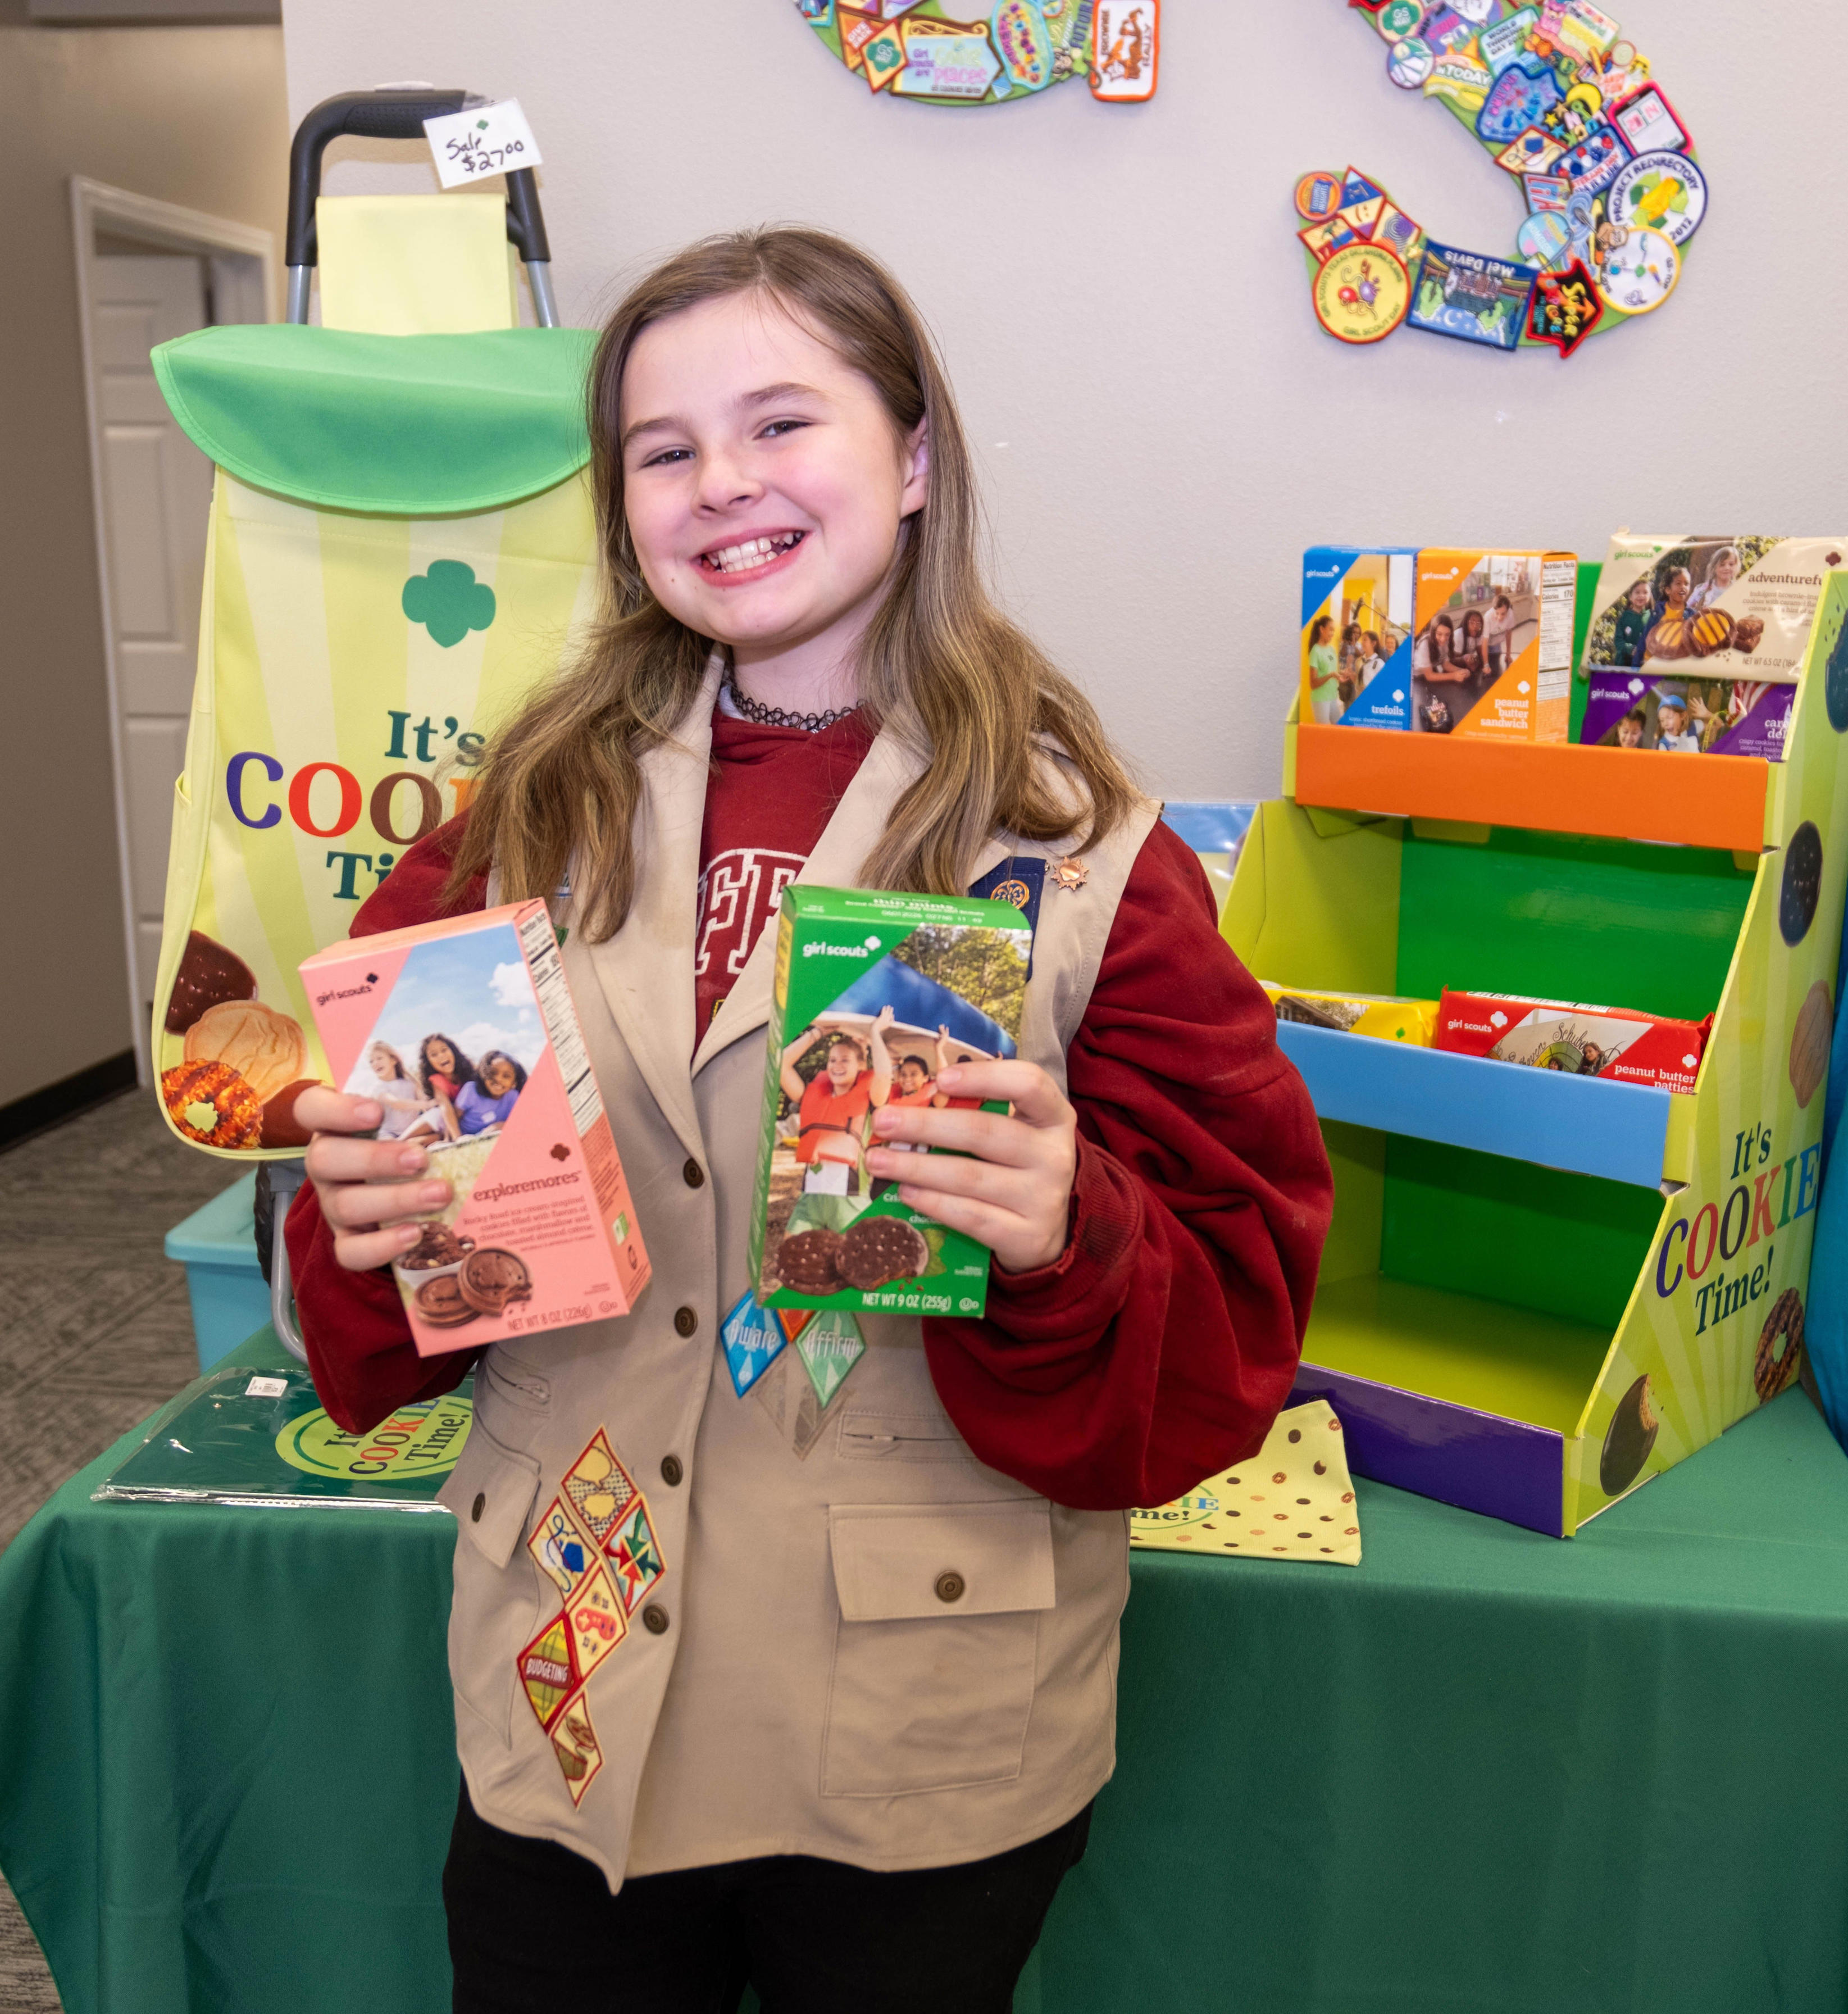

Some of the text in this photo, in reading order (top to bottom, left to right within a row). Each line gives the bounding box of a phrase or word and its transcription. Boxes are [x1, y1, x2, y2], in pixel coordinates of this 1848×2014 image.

[1069, 0, 1094, 49] FUTUR
[1445, 63, 1494, 85] TODAY
[1614, 171, 1636, 222] PROJECT
[1633, 157, 1699, 190] REDIRECTORY
[1669, 217, 1693, 240] 2012
[1444, 251, 1516, 279] Mel Davis
[1362, 319, 1390, 335] SCOUT
[1614, 550, 1627, 560] girl
[1742, 657, 1753, 665] NET
[1754, 657, 1763, 665] WT
[1773, 658, 1782, 667] OZ
[1782, 659, 1796, 668] (184
[1494, 698, 1529, 708] peanut
[1591, 689, 1630, 700] girl scouts
[1371, 704, 1404, 716] trefoils
[1498, 707, 1529, 719] butter
[1480, 717, 1528, 729] sandwich
[384, 710, 486, 767] It's
[326, 851, 394, 900] Ti
[803, 942, 869, 958] girl scouts
[316, 983, 372, 1006] girl scouts
[1448, 1019, 1492, 1033] girl scouts
[1552, 1022, 1586, 1051] Schube
[1614, 1065, 1696, 1084] peanut butter
[1654, 1080, 1695, 1094] patties
[1729, 1120, 1772, 1180] It's
[472, 1172, 580, 1202] exploremores
[1655, 1142, 1821, 1298] COOKIE
[1694, 1244, 1774, 1336] Time!
[862, 1293, 952, 1313] NET WT 9 OZ (255g)
[507, 1318, 524, 1331] NET
[527, 1314, 540, 1328] WT
[548, 1310, 562, 1322] OZ
[404, 1412, 470, 1461] Time!
[1130, 1510, 1190, 1521] me!
[526, 1658, 569, 1683] BUDGETING
